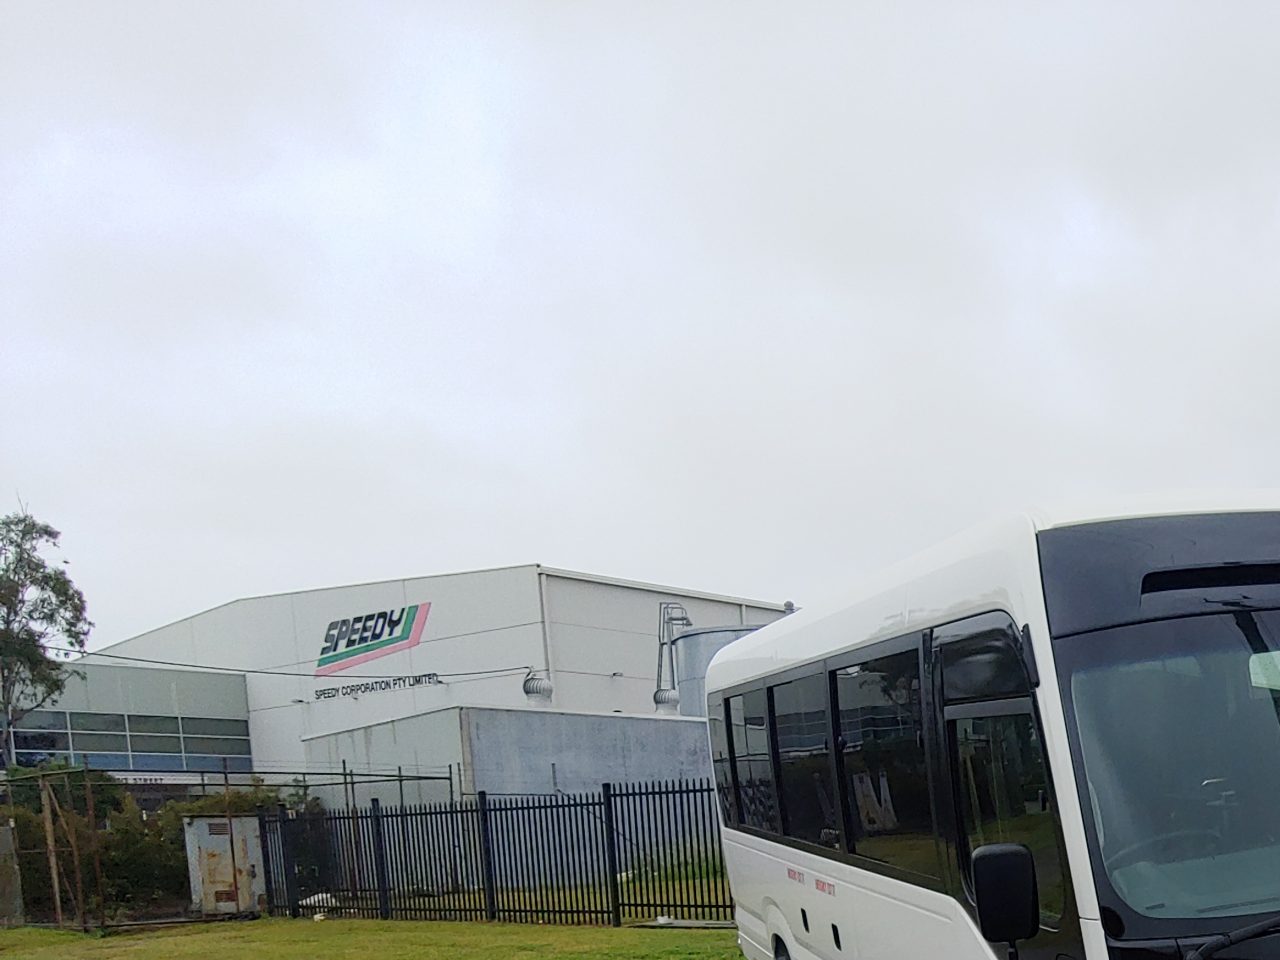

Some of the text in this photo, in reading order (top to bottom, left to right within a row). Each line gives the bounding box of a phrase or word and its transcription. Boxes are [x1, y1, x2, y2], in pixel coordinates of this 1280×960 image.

[320, 607, 406, 656] SPEEDY
[315, 673, 438, 700] SPEEDY CORPORATION PTY LIMITED
